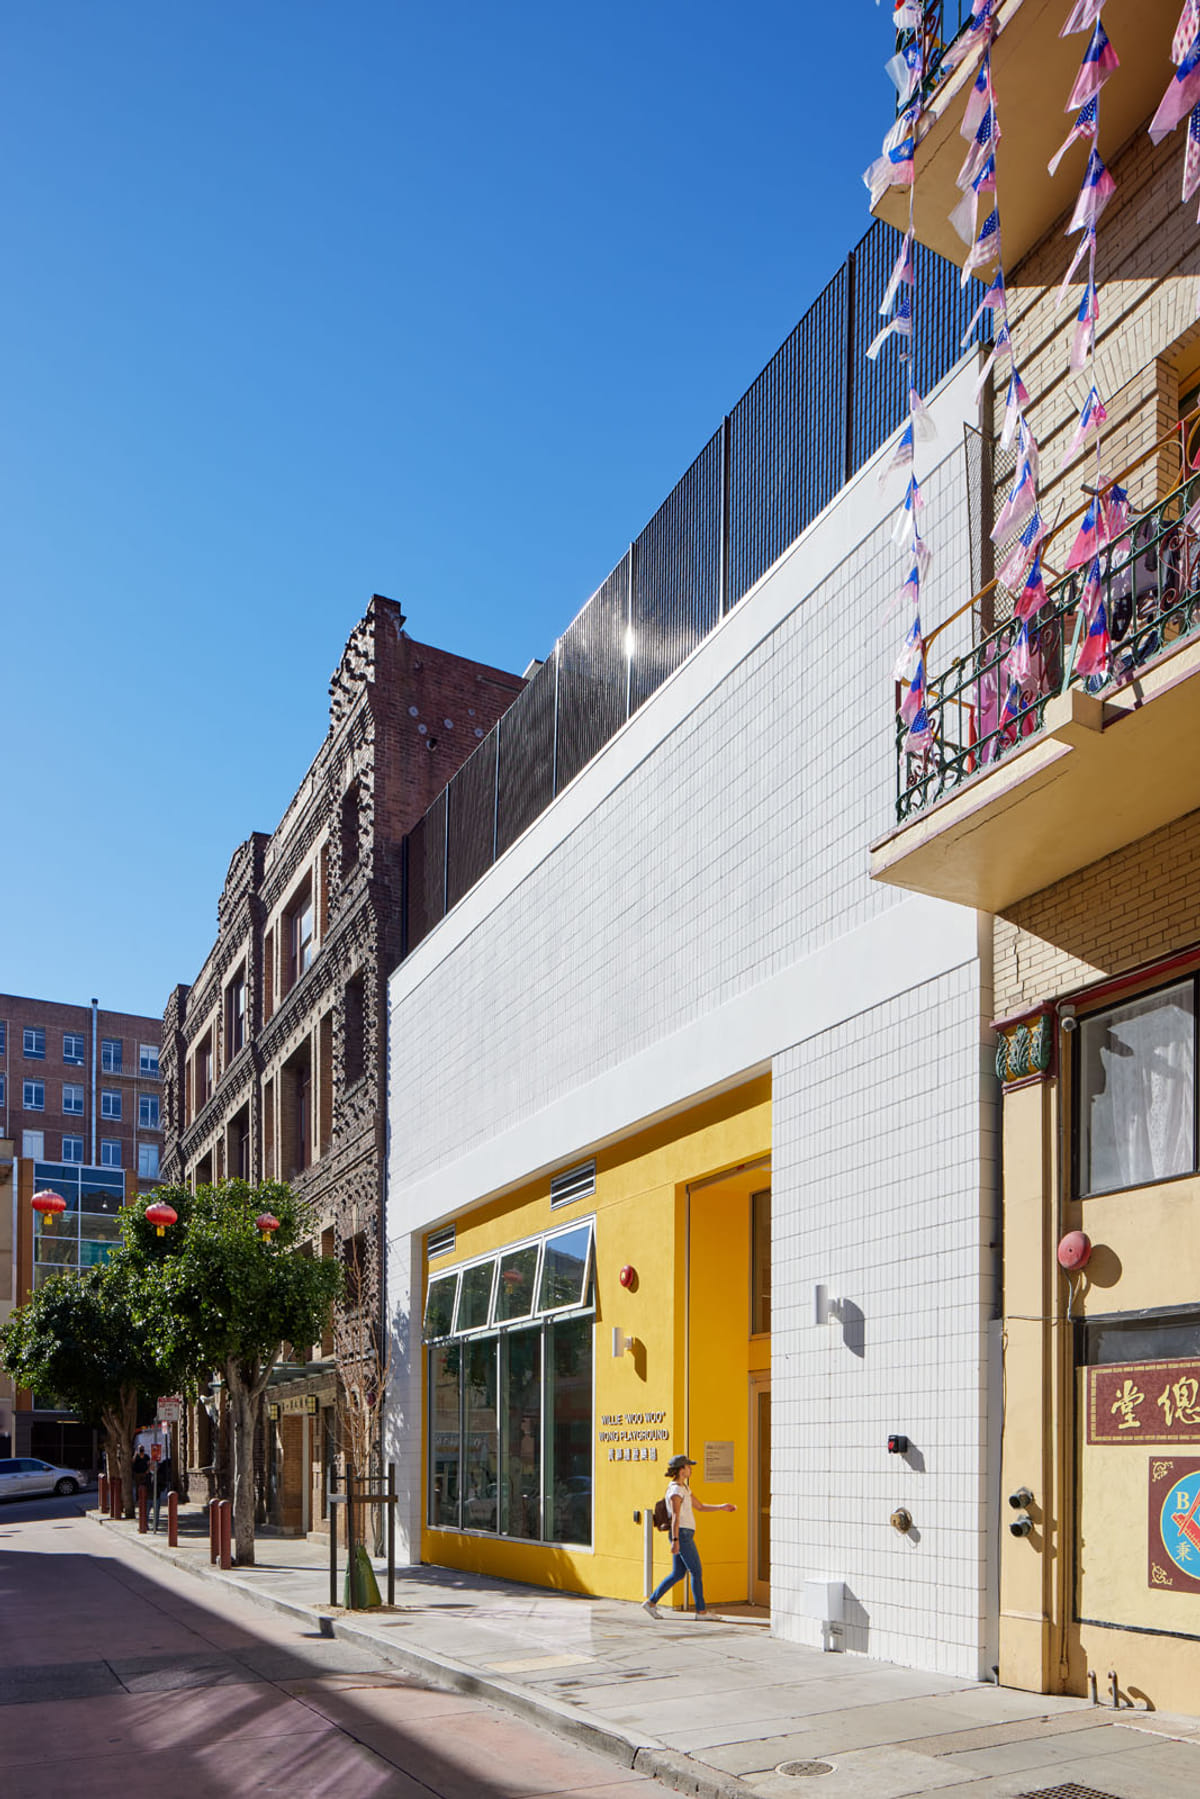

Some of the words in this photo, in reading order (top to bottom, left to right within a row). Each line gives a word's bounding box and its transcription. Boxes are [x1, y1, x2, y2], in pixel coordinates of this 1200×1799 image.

[599, 1430, 620, 1442] WONG
[620, 1428, 669, 1442] PLAYGROUND
[1176, 1491, 1190, 1510] B
